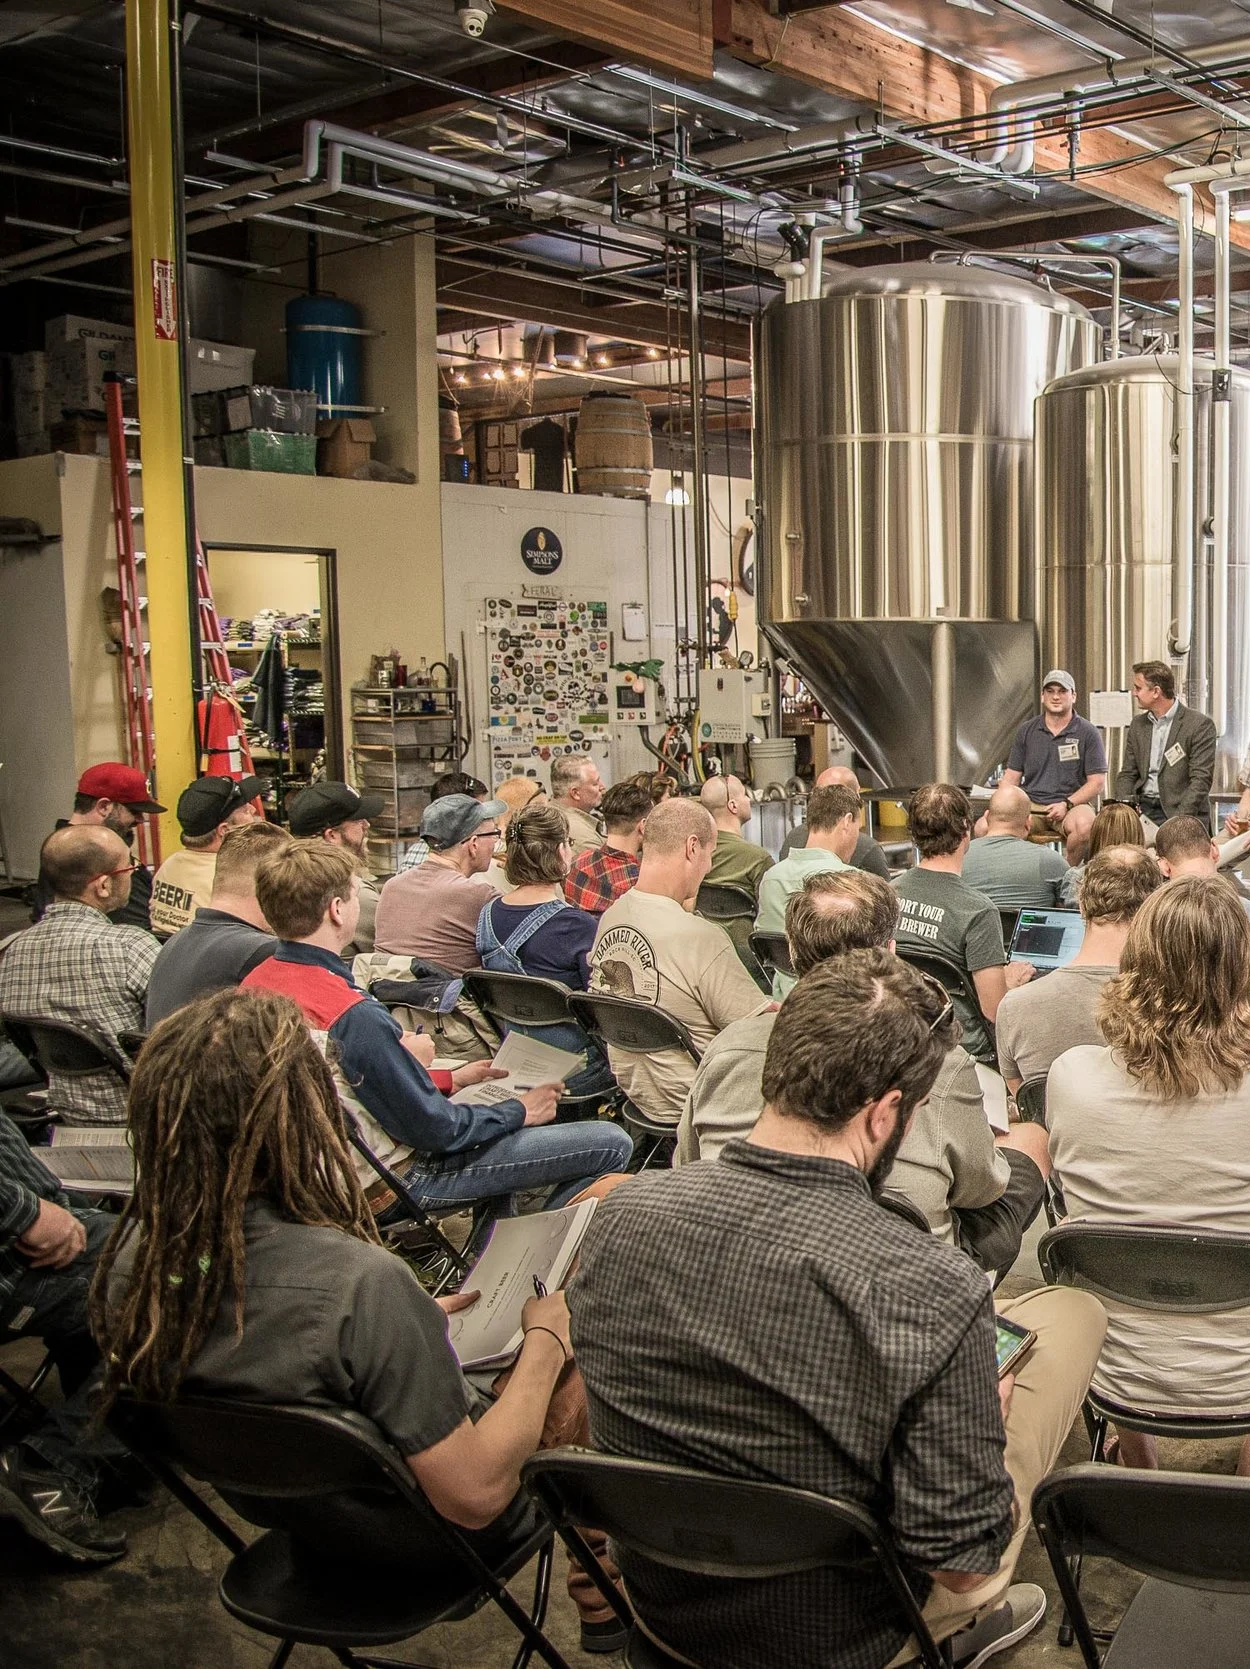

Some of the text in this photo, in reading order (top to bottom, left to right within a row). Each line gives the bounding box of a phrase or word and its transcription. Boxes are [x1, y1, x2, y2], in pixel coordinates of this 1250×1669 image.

[526, 549, 559, 560] SIMPSONS
[533, 557, 553, 565] MALT
[153, 880, 184, 909] BEER
[918, 903, 945, 923] YOUR
[899, 917, 939, 940] BREWER
[595, 929, 653, 970] DAMMED RIVER
[486, 1271, 510, 1309] CRAFT BEER
